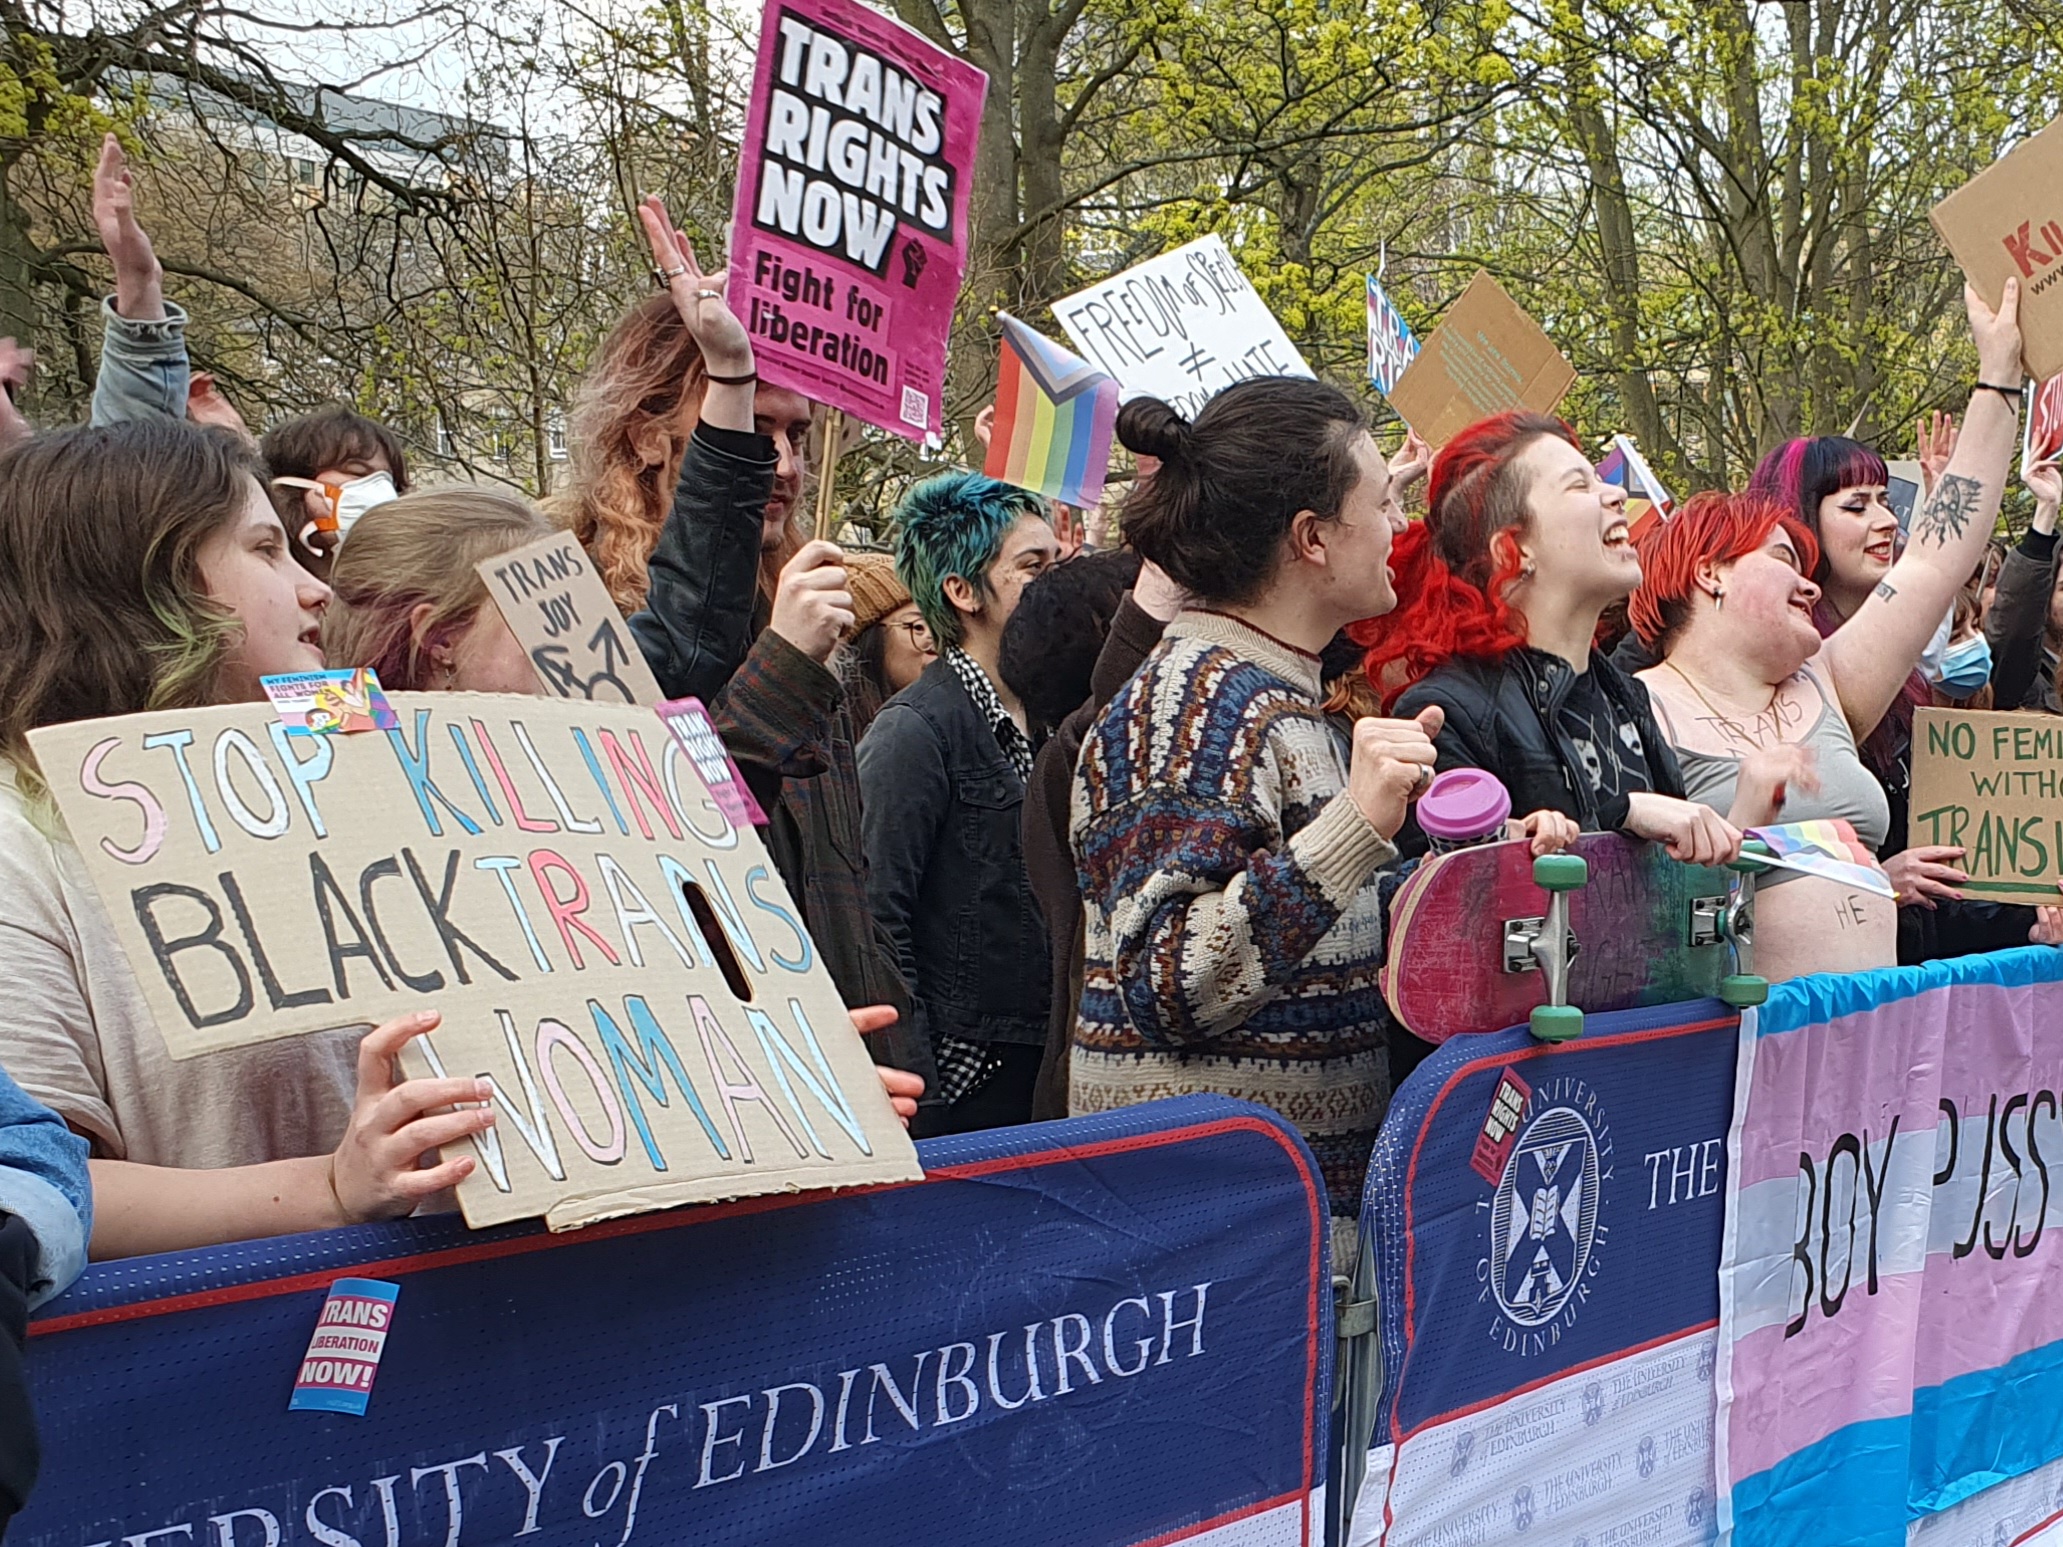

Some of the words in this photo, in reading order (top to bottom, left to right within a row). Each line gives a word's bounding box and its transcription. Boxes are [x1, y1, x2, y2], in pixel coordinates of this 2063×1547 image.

[778, 15, 941, 156] TRANS
[766, 89, 949, 230] RIGHTS
[757, 159, 897, 271] NOW
[754, 250, 834, 312] Fight
[847, 285, 884, 333] for
[748, 296, 889, 387] liberation
[494, 545, 584, 605] TRANS
[538, 591, 582, 638] JOY
[1929, 720, 1976, 760] NO
[80, 720, 333, 866] STOP
[388, 709, 739, 850] KILLING
[1917, 804, 2048, 878] TRANS
[132, 847, 520, 1029] BLACK
[474, 848, 814, 974] TRANS
[416, 996, 874, 1193] WOMAN
[1644, 1138, 1722, 1211] THE
[321, 1299, 389, 1328] TRANS
[1489, 1225, 1609, 1357] EDINBURGH
[299, 1361, 374, 1388] NOW!
[582, 1403, 677, 1547] of
[692, 1281, 1212, 1489] EDINBURGH
